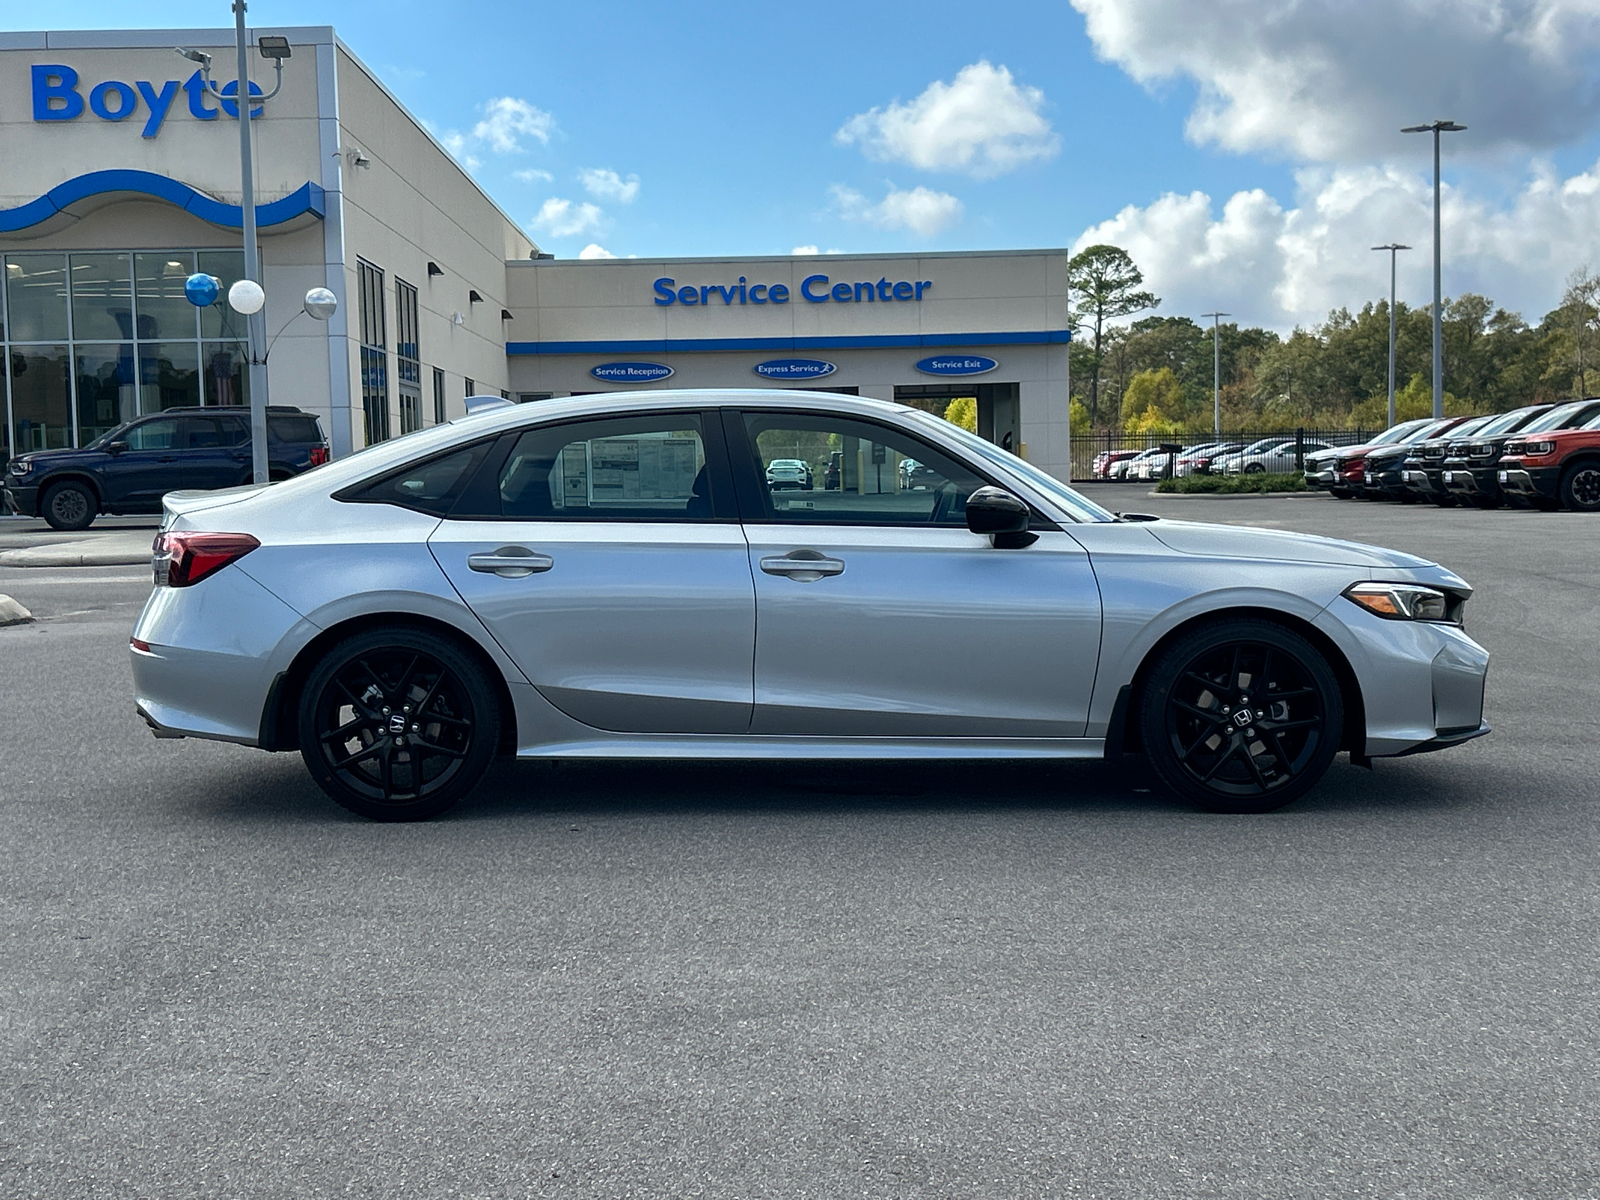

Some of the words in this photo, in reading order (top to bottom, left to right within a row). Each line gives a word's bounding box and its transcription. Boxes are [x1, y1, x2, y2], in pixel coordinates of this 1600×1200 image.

[31, 64, 264, 138] Boyte
[653, 276, 789, 306] Service
[800, 274, 932, 303] Center
[758, 365, 788, 374] Express
[789, 364, 820, 373] Service
[932, 361, 963, 369] Service
[964, 360, 981, 368] Exit
[595, 367, 626, 375] Service
[627, 367, 669, 377] Reception
